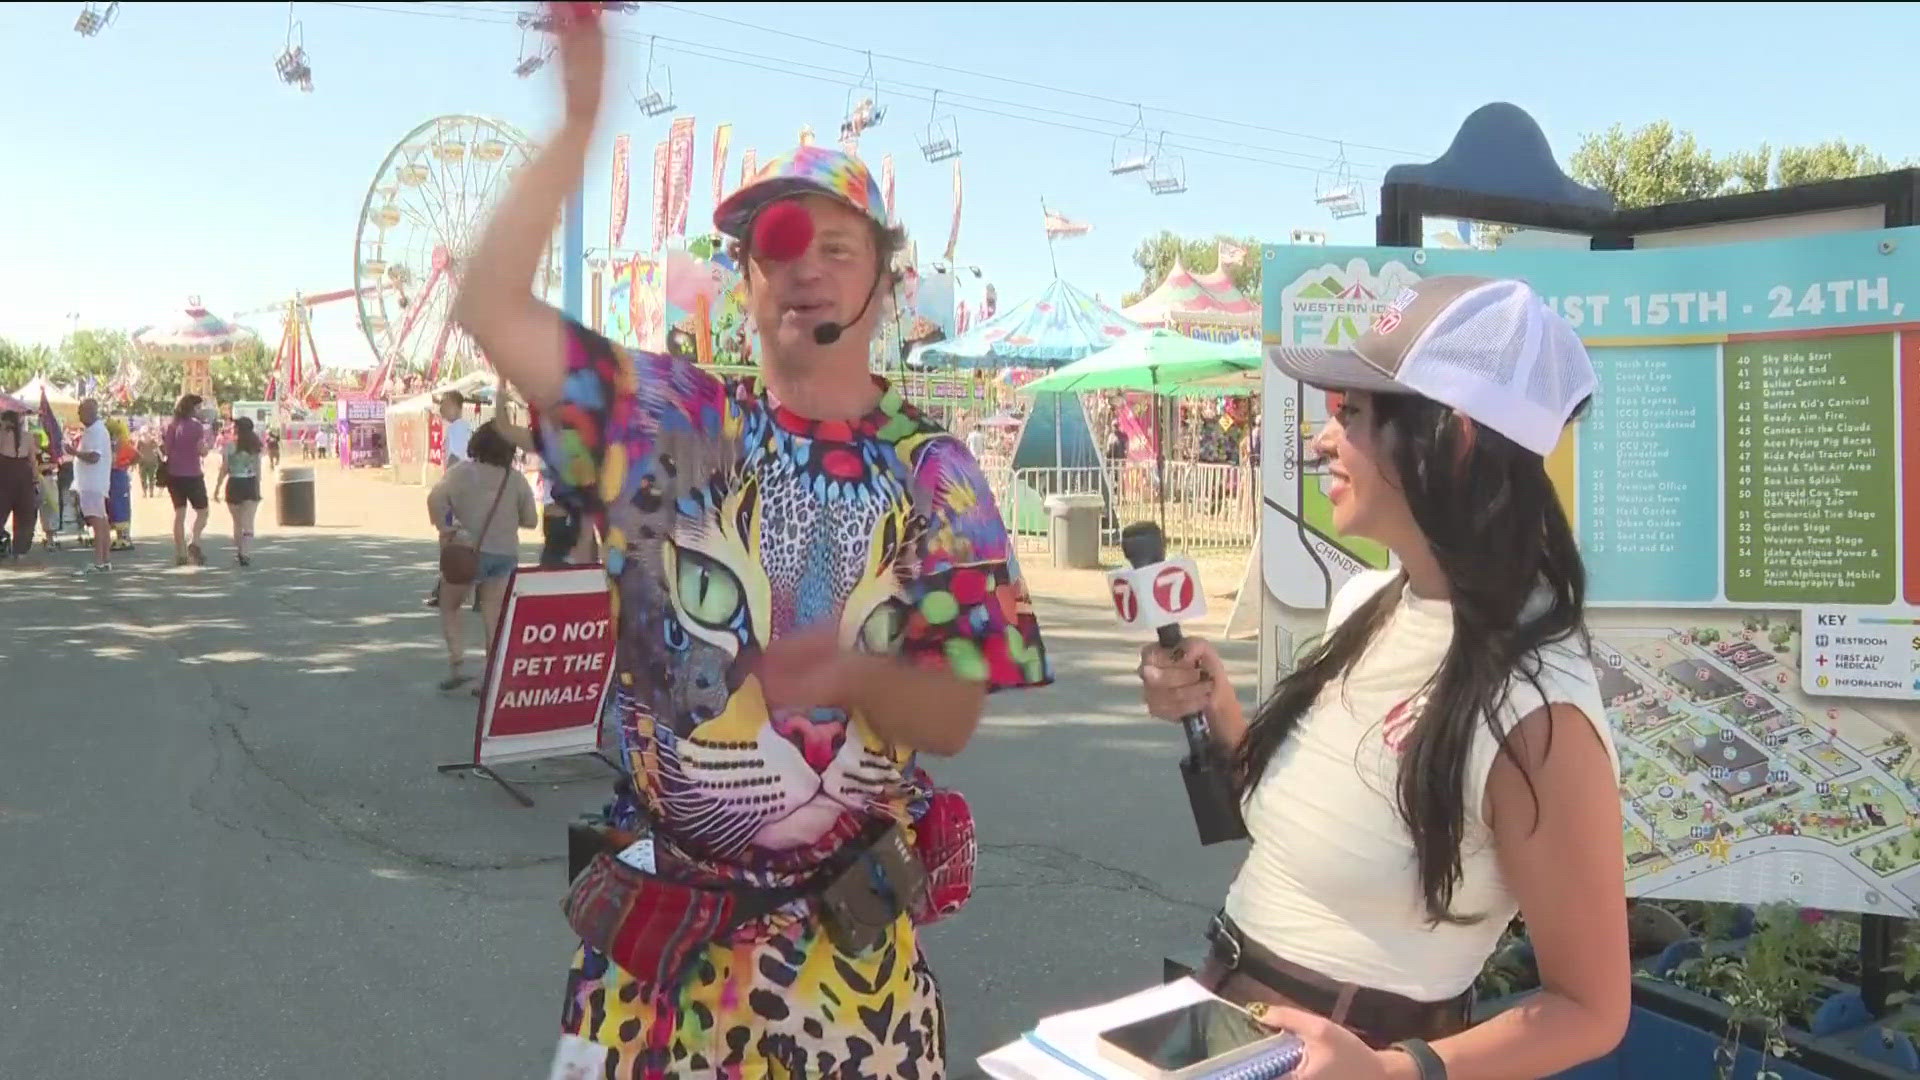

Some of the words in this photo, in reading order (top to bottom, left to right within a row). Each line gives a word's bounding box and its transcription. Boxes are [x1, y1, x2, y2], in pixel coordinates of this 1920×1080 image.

[1293, 301, 1368, 313] WESTERN
[1624, 290, 1727, 326] 15TH
[1767, 277, 1905, 319] 24TH,
[1737, 356, 1751, 365] 40
[1762, 355, 1779, 365] Sky
[1783, 353, 1805, 363] Ride
[1808, 352, 1832, 361] Start
[1737, 368, 1749, 377] 41
[1762, 367, 1780, 377] Sky
[1783, 365, 1805, 375] Ride
[1808, 363, 1827, 374] End
[1738, 381, 1751, 390] 42
[1795, 376, 1836, 387] Carnival
[1839, 375, 1847, 385] &
[1763, 388, 1795, 397] Games
[1738, 402, 1750, 411] 43
[1763, 401, 1797, 410] Butlers
[1800, 399, 1824, 409] Kid's
[1828, 396, 1869, 407] Carnival
[1616, 409, 1639, 418] ICCU
[1642, 407, 1696, 418] Grandstand
[1738, 414, 1751, 423] 44
[1616, 421, 1639, 430] ICCU
[1642, 420, 1696, 430] Grandstand
[1738, 427, 1751, 435] 45
[1763, 425, 1801, 435] Canines
[1804, 424, 1814, 433] in
[1817, 423, 1833, 433] the
[1836, 422, 1871, 433] Clouds
[430, 414, 442, 459] ATM
[1283, 396, 1295, 481] GLENWOOD
[1739, 439, 1751, 448] 46
[1763, 439, 1786, 448] Aces
[1789, 437, 1819, 448] Flying
[1823, 436, 1840, 447] Pig
[1843, 436, 1872, 445] Races
[1616, 441, 1639, 450] ICCU
[1739, 452, 1751, 460] 47
[1763, 450, 1785, 460] Kids
[1788, 449, 1815, 460] Pedal
[1818, 449, 1853, 459] Tractor
[1856, 448, 1876, 458] Pull
[1739, 465, 1751, 473] 48
[1763, 464, 1789, 473] Make
[1803, 463, 1825, 472] Take
[1829, 463, 1844, 471] Art
[1847, 462, 1872, 472] Area
[1637, 469, 1659, 479] Club
[1739, 477, 1751, 486] 49
[1763, 476, 1781, 485] Sea
[1785, 475, 1805, 485] Lion
[1809, 475, 1841, 486] Splash
[1658, 482, 1687, 491] Office
[1739, 489, 1751, 498] 50
[1809, 488, 1829, 497] Cow
[1834, 487, 1858, 497] Town
[1763, 498, 1784, 506] USA
[1788, 498, 1822, 508] Petting
[1825, 497, 1845, 506] Zoo
[1642, 506, 1677, 516] Garden
[1739, 511, 1750, 519] 51
[1763, 509, 1820, 519] Commercial
[1824, 509, 1844, 519] Tire
[1847, 509, 1876, 520] Stage
[1616, 519, 1643, 528] Urban
[1646, 519, 1681, 528] Garden
[1739, 523, 1751, 532] 52
[1763, 523, 1800, 532] Garden
[1803, 523, 1831, 534] Stage
[1739, 536, 1751, 544] 53
[1763, 535, 1804, 545] Western
[1807, 535, 1832, 545] Town
[1835, 535, 1863, 546] Stage
[1739, 548, 1751, 557] 54
[1763, 547, 1791, 557] Idaho
[1795, 548, 1832, 558] Antique
[1836, 548, 1867, 557] Power
[1870, 548, 1878, 557] &
[1763, 557, 1787, 565] Farm
[1790, 556, 1843, 567] Equipment
[1739, 569, 1751, 578] 55
[1763, 568, 1788, 578] Saint
[1792, 569, 1842, 580] Alphonsus
[1846, 569, 1880, 579] Mobile
[1763, 578, 1834, 588] Mammography
[1838, 578, 1855, 587] Bus
[1156, 570, 1186, 611] 7
[1113, 584, 1131, 620] 7
[1818, 614, 1847, 626] KEY
[522, 624, 557, 645] DO
[562, 619, 609, 642] NOT
[1835, 637, 1888, 646] RESTROOM
[512, 655, 557, 677] PET
[563, 652, 606, 675] THE
[1835, 654, 1861, 662] FIRST
[1863, 655, 1885, 664] AID/
[1835, 661, 1878, 671] MEDICAL
[1835, 678, 1902, 689] INFORMATION
[499, 682, 600, 709] ANIMALS
